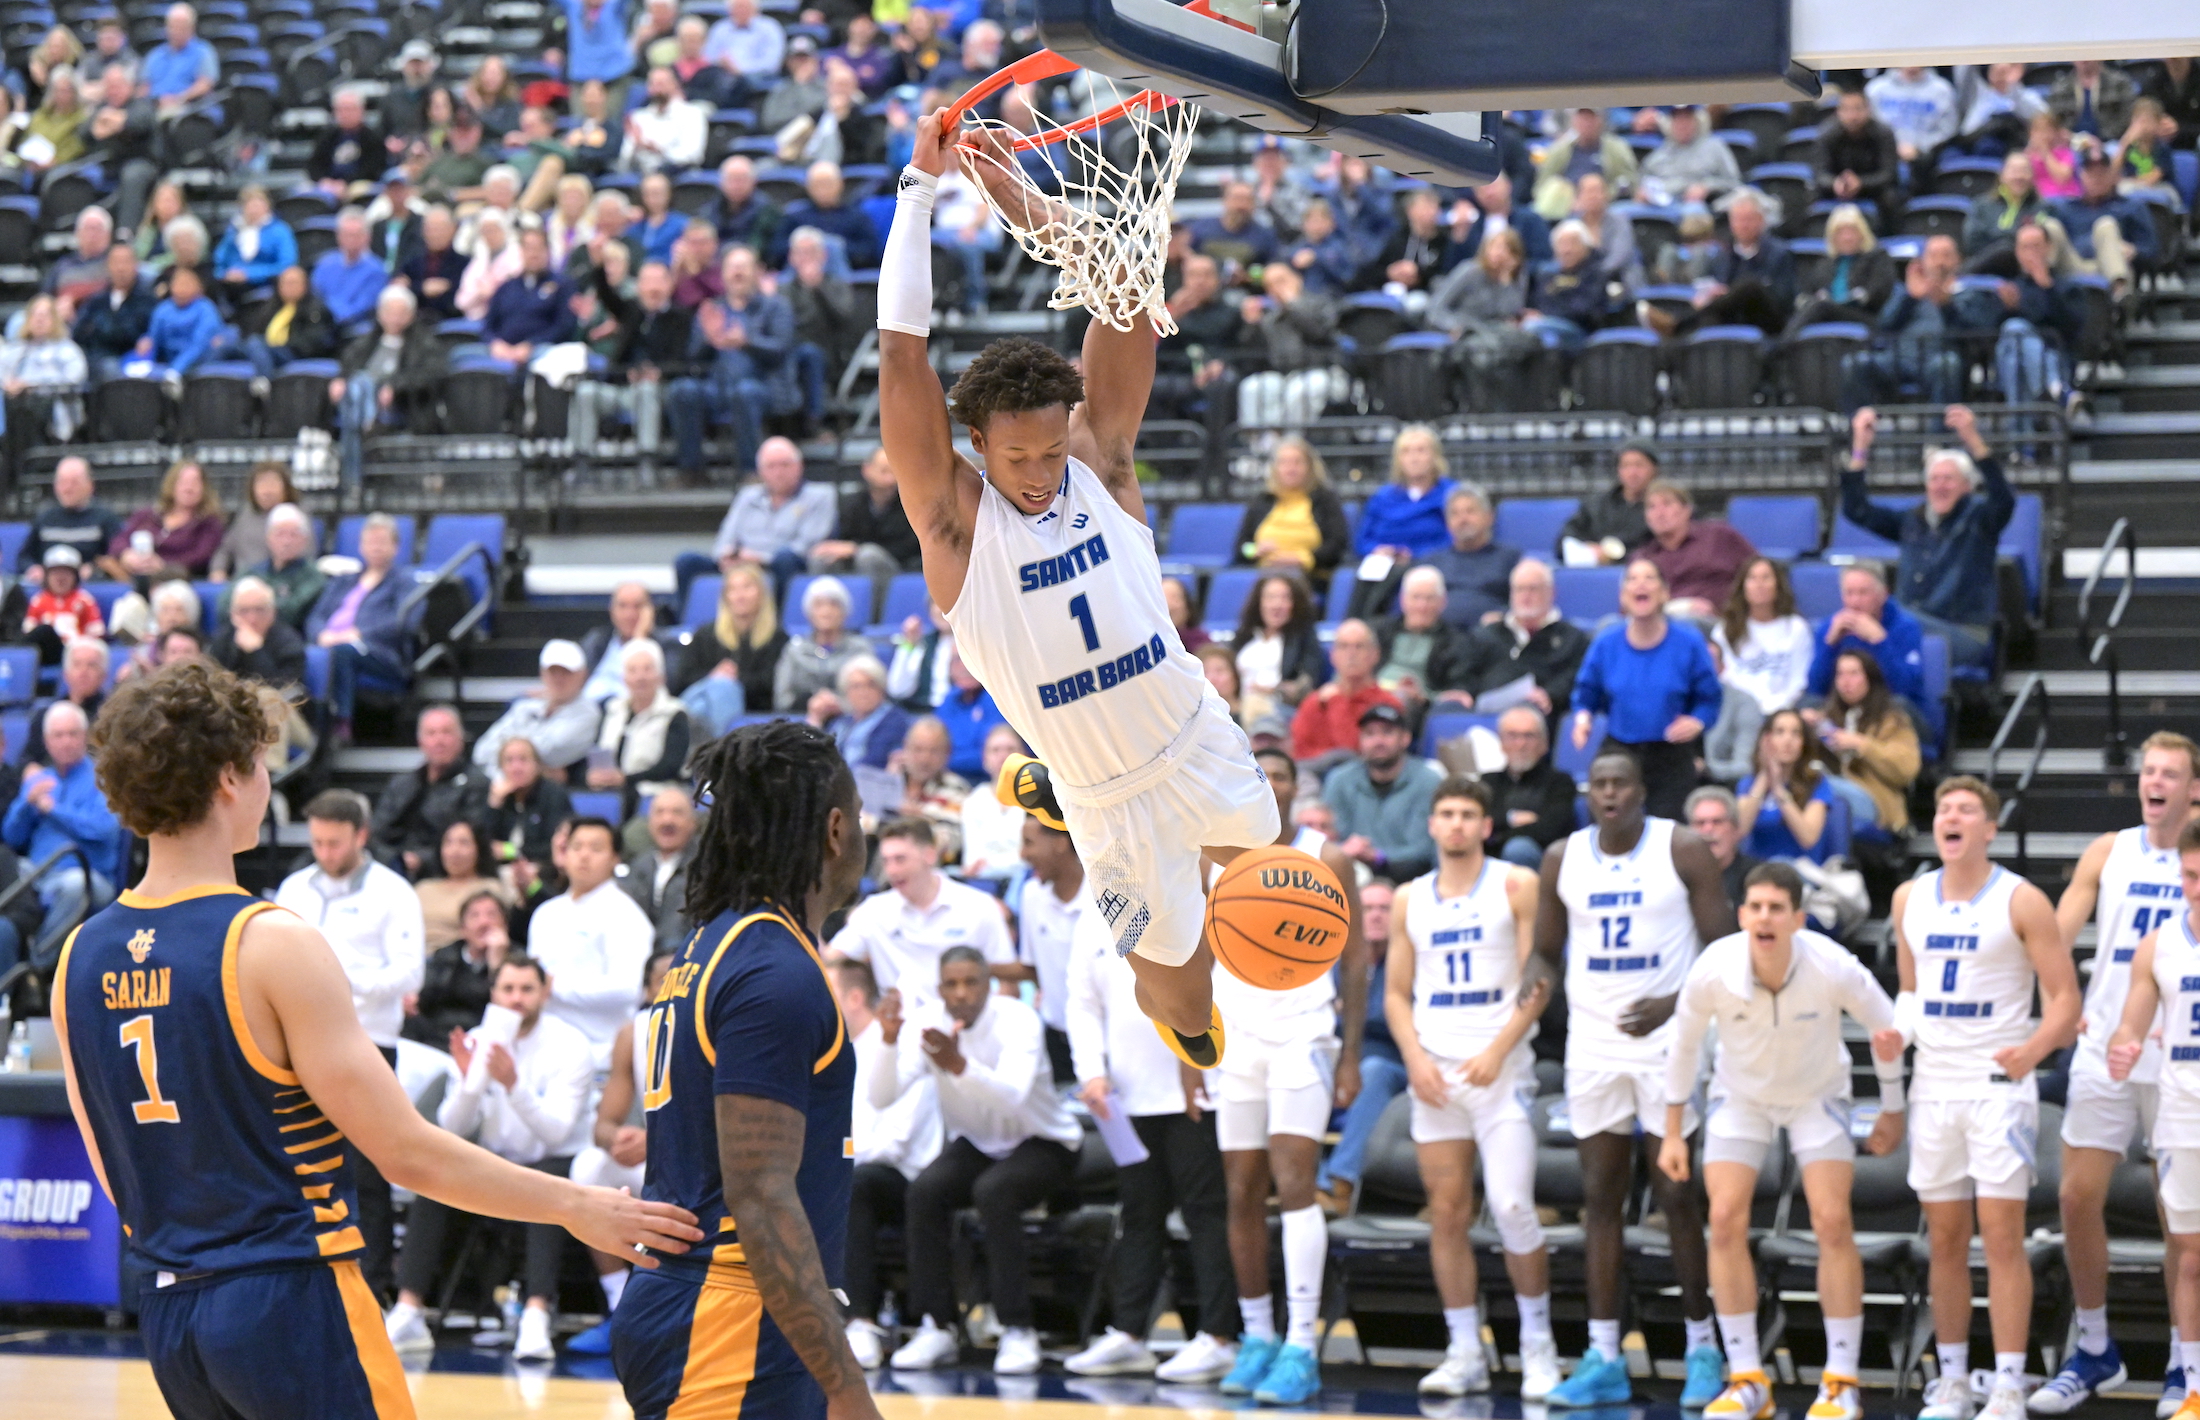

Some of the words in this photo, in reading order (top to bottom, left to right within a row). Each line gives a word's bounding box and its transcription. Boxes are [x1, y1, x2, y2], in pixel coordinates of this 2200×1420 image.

[1018, 532, 1111, 594] SANTA
[1068, 591, 1102, 654] 1
[1037, 632, 1167, 709] BARBARA
[1258, 868, 1346, 912] Wilson
[1588, 890, 1642, 909] SANTA
[1274, 920, 1329, 946] EVO
[1431, 925, 1482, 946] SANTA
[1601, 915, 1630, 949] 12
[1925, 933, 1980, 951] SANTA
[102, 967, 171, 1010] SARAN
[1445, 950, 1471, 985] 11
[119, 1015, 181, 1124] 1
[0, 1179, 93, 1224] GROUP
